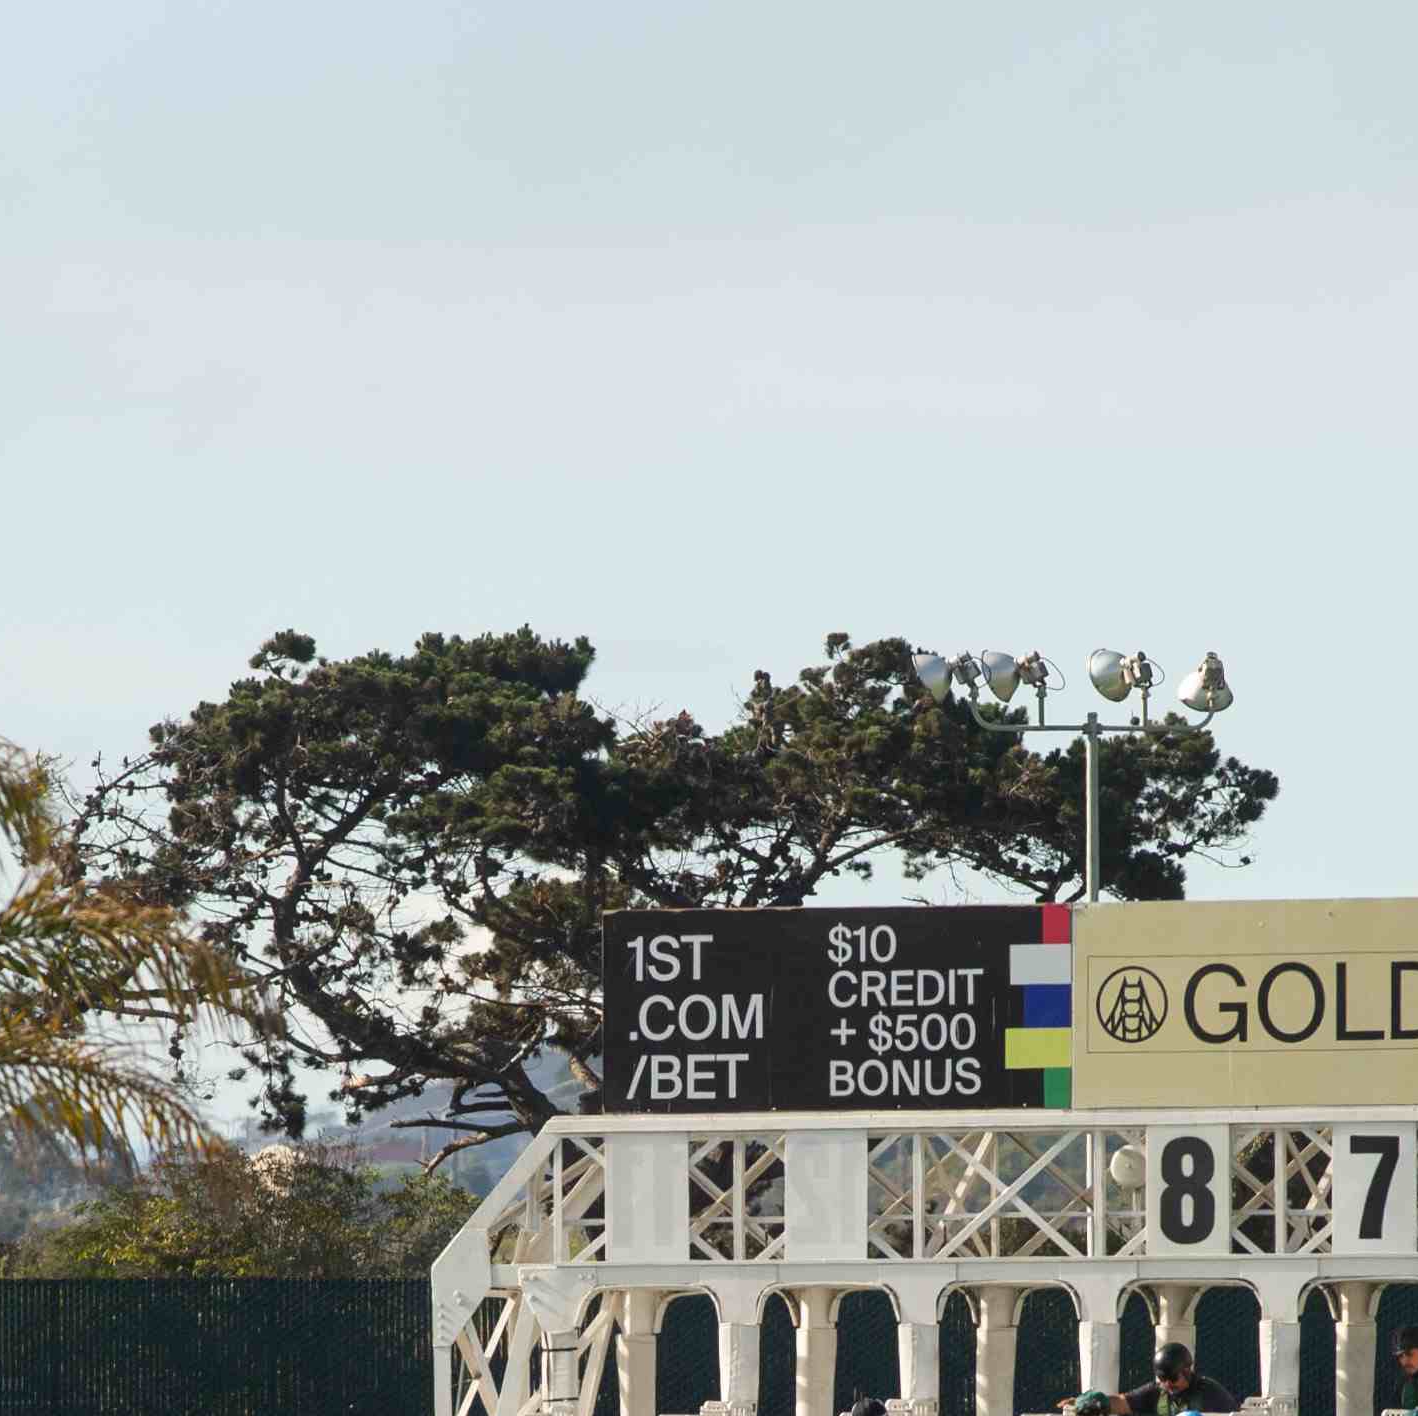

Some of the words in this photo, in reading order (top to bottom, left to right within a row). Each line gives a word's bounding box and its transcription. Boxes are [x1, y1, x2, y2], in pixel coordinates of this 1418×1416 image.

[626, 934, 714, 983] 1ST
[827, 922, 898, 968] $10
[827, 968, 984, 1009] CREDIT
[628, 993, 765, 1042] .COM
[829, 1018, 858, 1047] +
[867, 1010, 977, 1056] $500
[626, 1053, 750, 1101] /BET
[828, 1057, 983, 1098] BONUS
[1159, 1136, 1216, 1245] 8
[1348, 1135, 1401, 1240] 7
